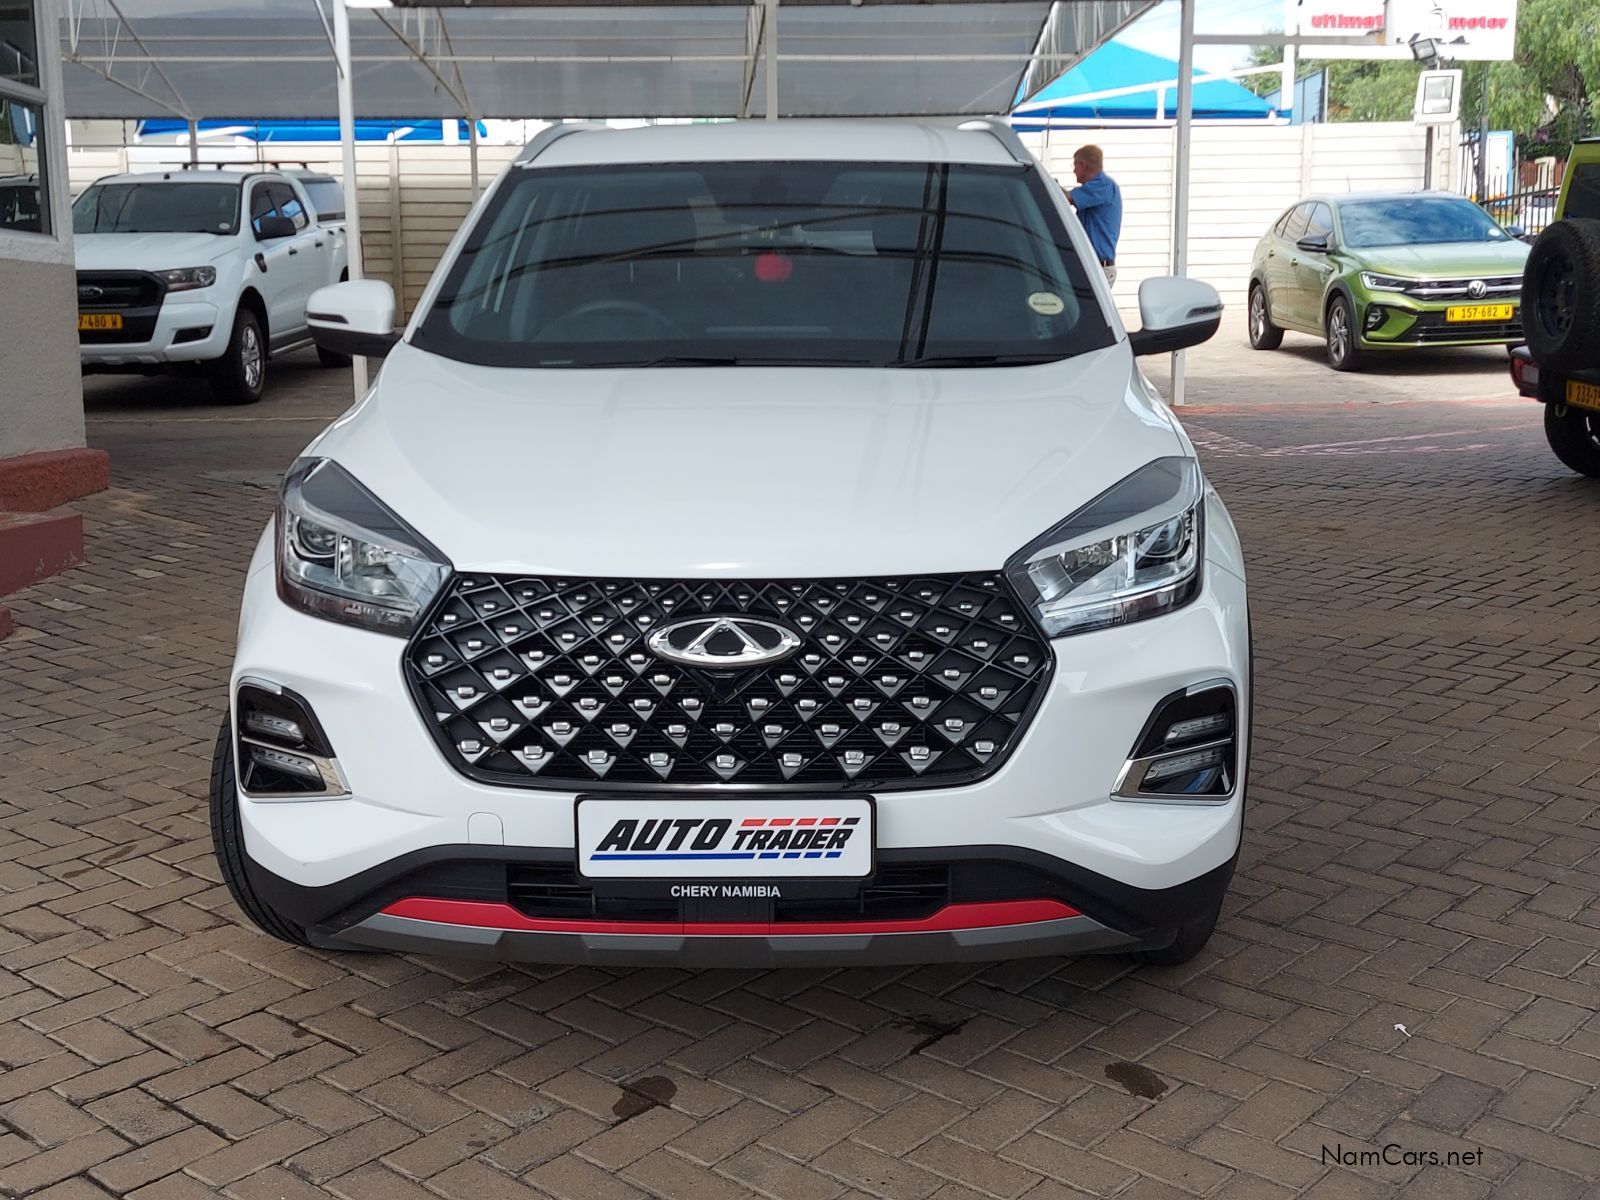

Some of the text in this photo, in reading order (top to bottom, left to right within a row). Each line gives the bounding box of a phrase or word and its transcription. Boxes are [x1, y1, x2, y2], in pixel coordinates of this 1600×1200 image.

[1449, 16, 1508, 30] motor
[1449, 308, 1454, 319] N
[1461, 307, 1498, 319] 157-682
[595, 818, 854, 852] AUTO TRADER
[670, 885, 781, 898] CHERY NAMIBIA
